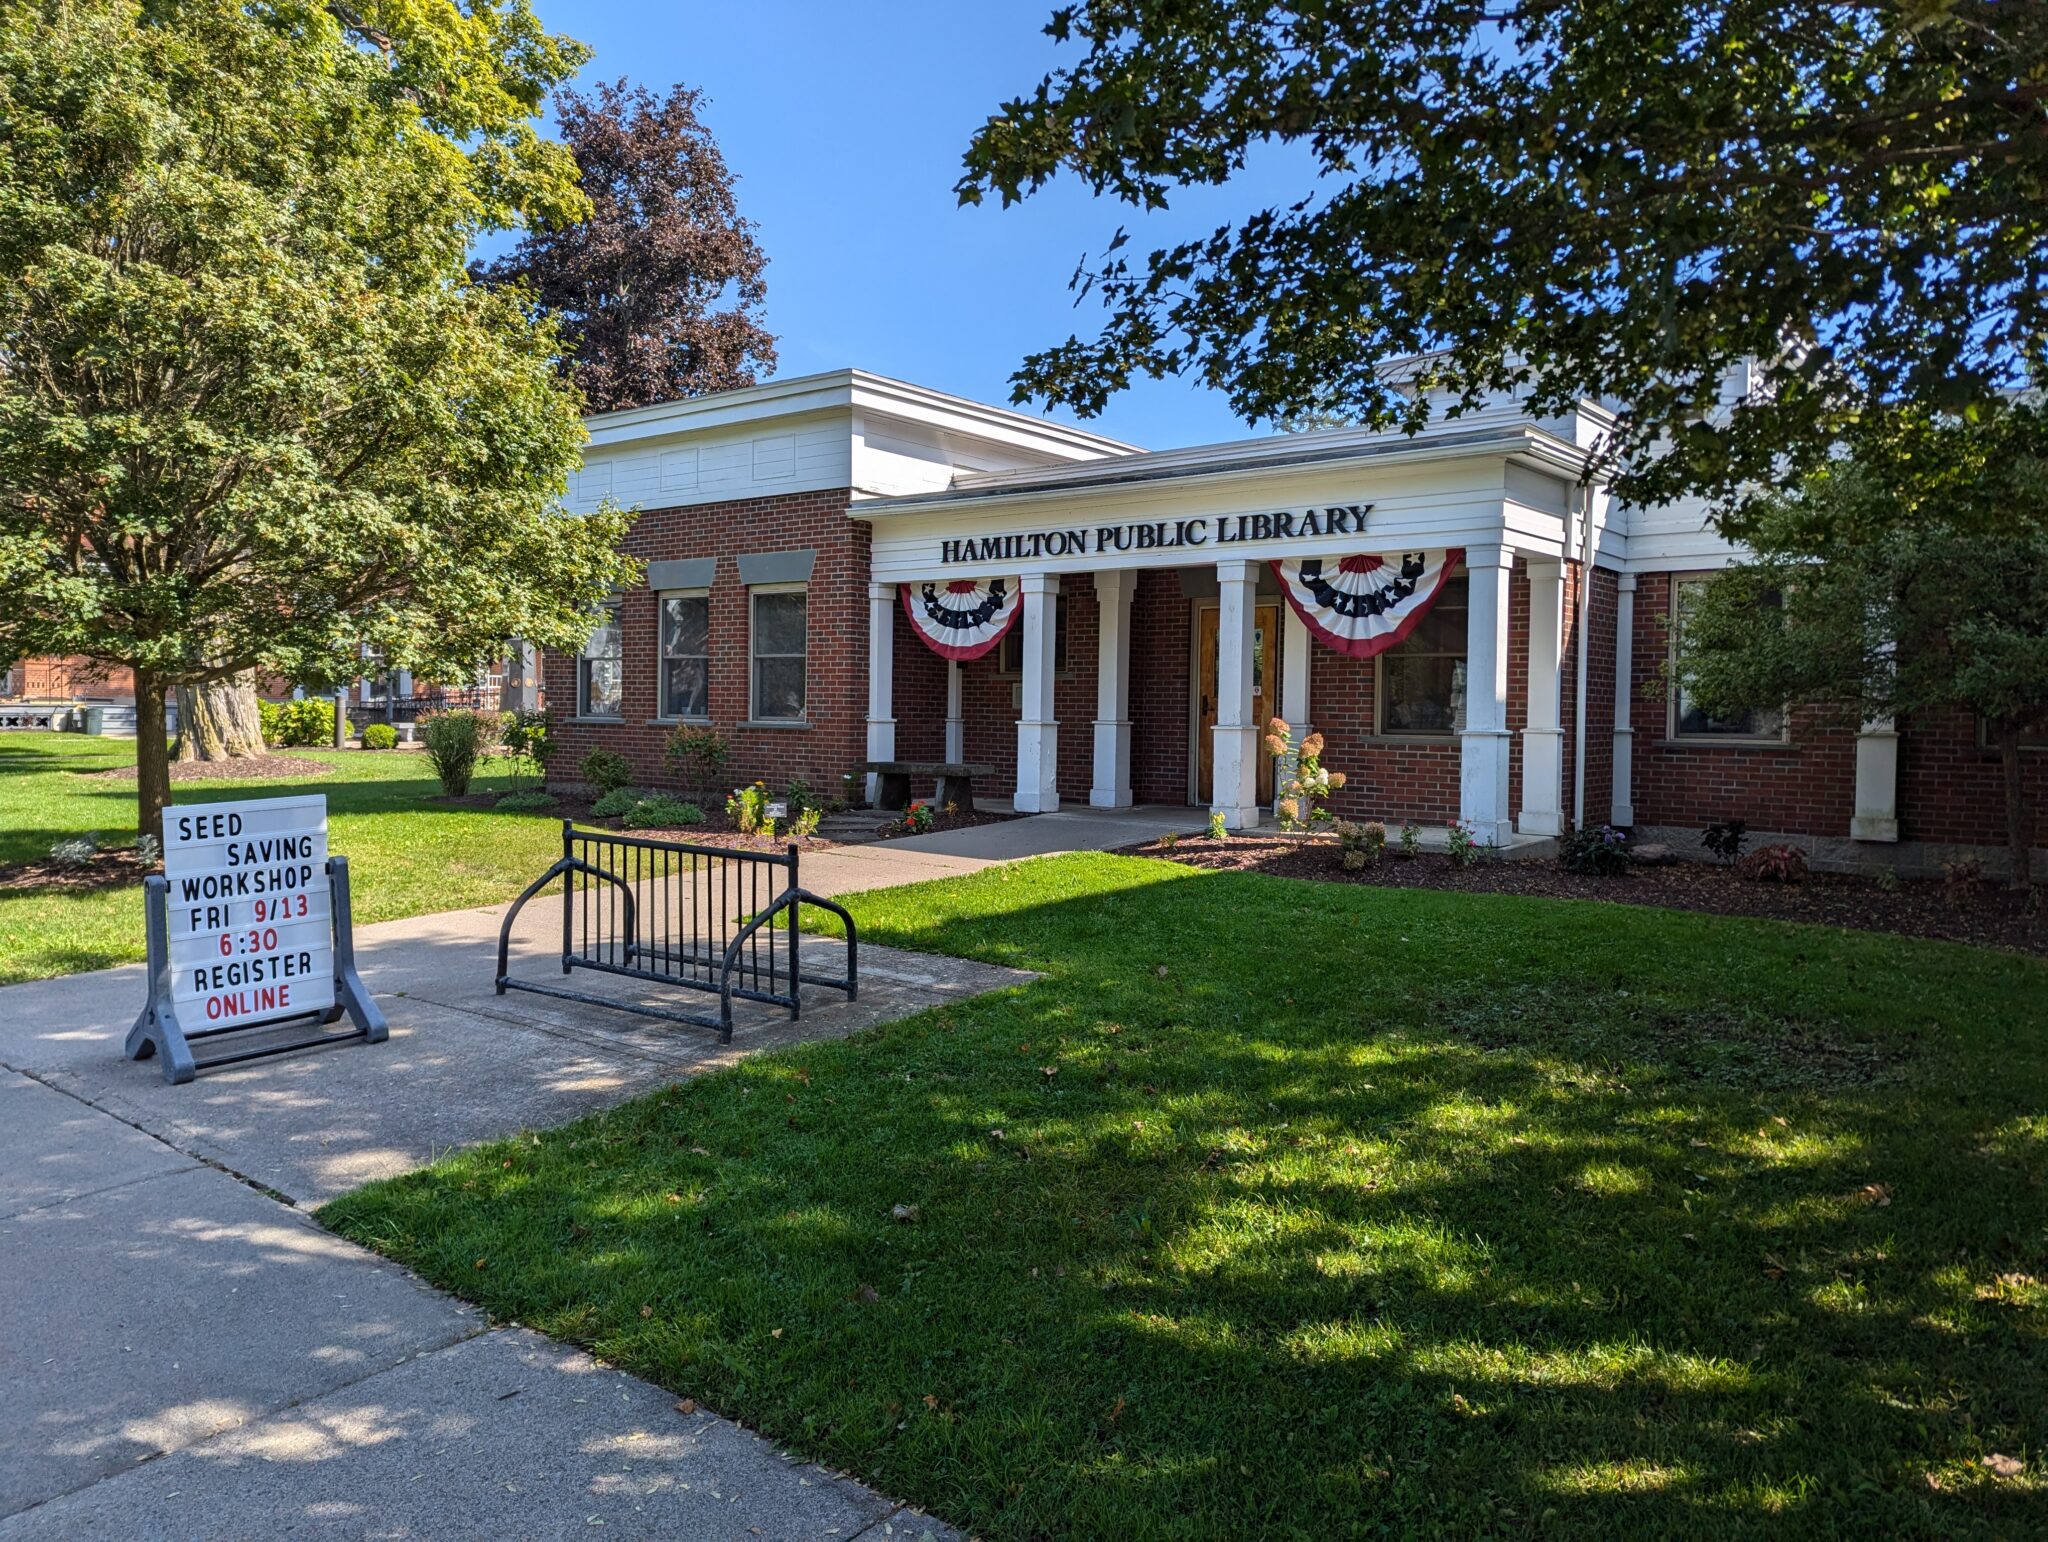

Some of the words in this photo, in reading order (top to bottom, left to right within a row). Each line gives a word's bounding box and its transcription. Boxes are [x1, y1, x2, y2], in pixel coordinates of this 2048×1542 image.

[941, 529, 1087, 563] HAMILTON
[1095, 519, 1207, 552] PUBLIC
[1215, 504, 1374, 543] LIBRARY
[179, 813, 242, 841] SEED
[227, 836, 312, 866] SAVING
[182, 865, 312, 902] WORKSHOP
[191, 904, 230, 932] FRI
[254, 894, 308, 923] 9/13
[219, 928, 278, 956] 6:30
[194, 951, 312, 992] REGISTER
[206, 984, 290, 1020] ONLINE
